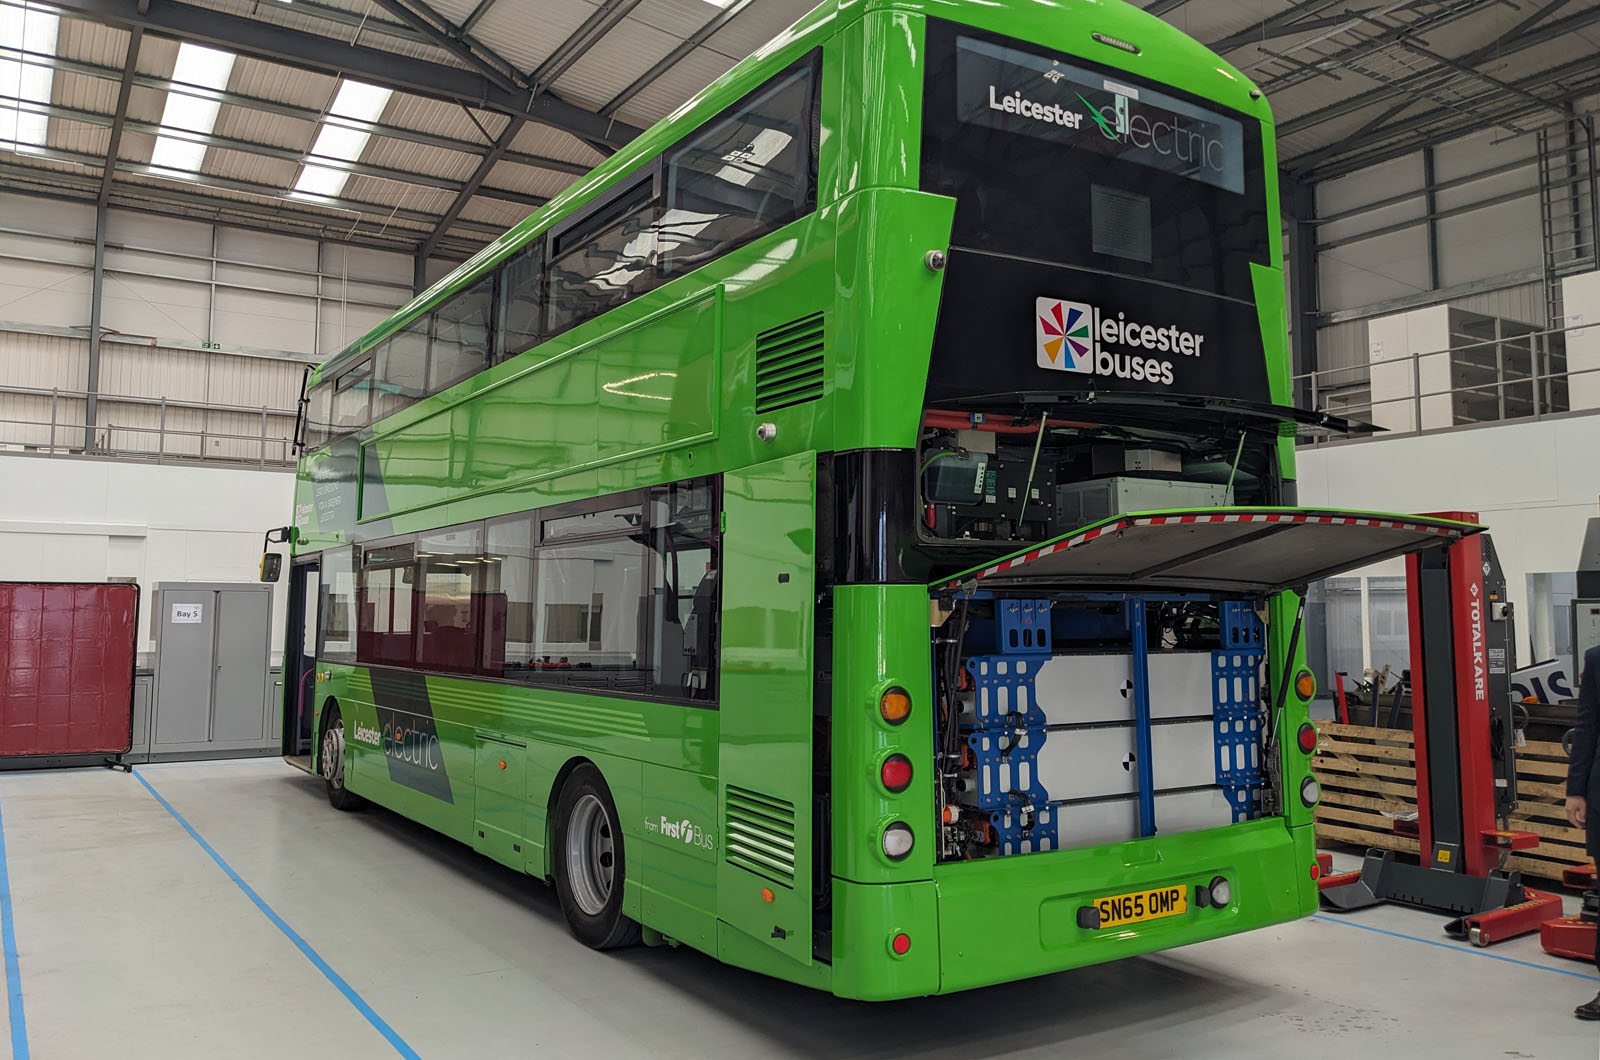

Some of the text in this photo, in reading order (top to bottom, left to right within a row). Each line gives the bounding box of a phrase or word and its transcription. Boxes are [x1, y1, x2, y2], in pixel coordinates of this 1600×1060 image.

[989, 85, 1225, 172] Leicester electric
[1094, 306, 1204, 357] leicester
[1095, 342, 1174, 385] buses
[176, 610, 198, 619] Bay 5
[1470, 598, 1485, 701] TOTALKARE
[354, 711, 439, 770] Leicester electric
[644, 815, 714, 850] from First Bus
[1100, 888, 1180, 923] SN65 OMP
